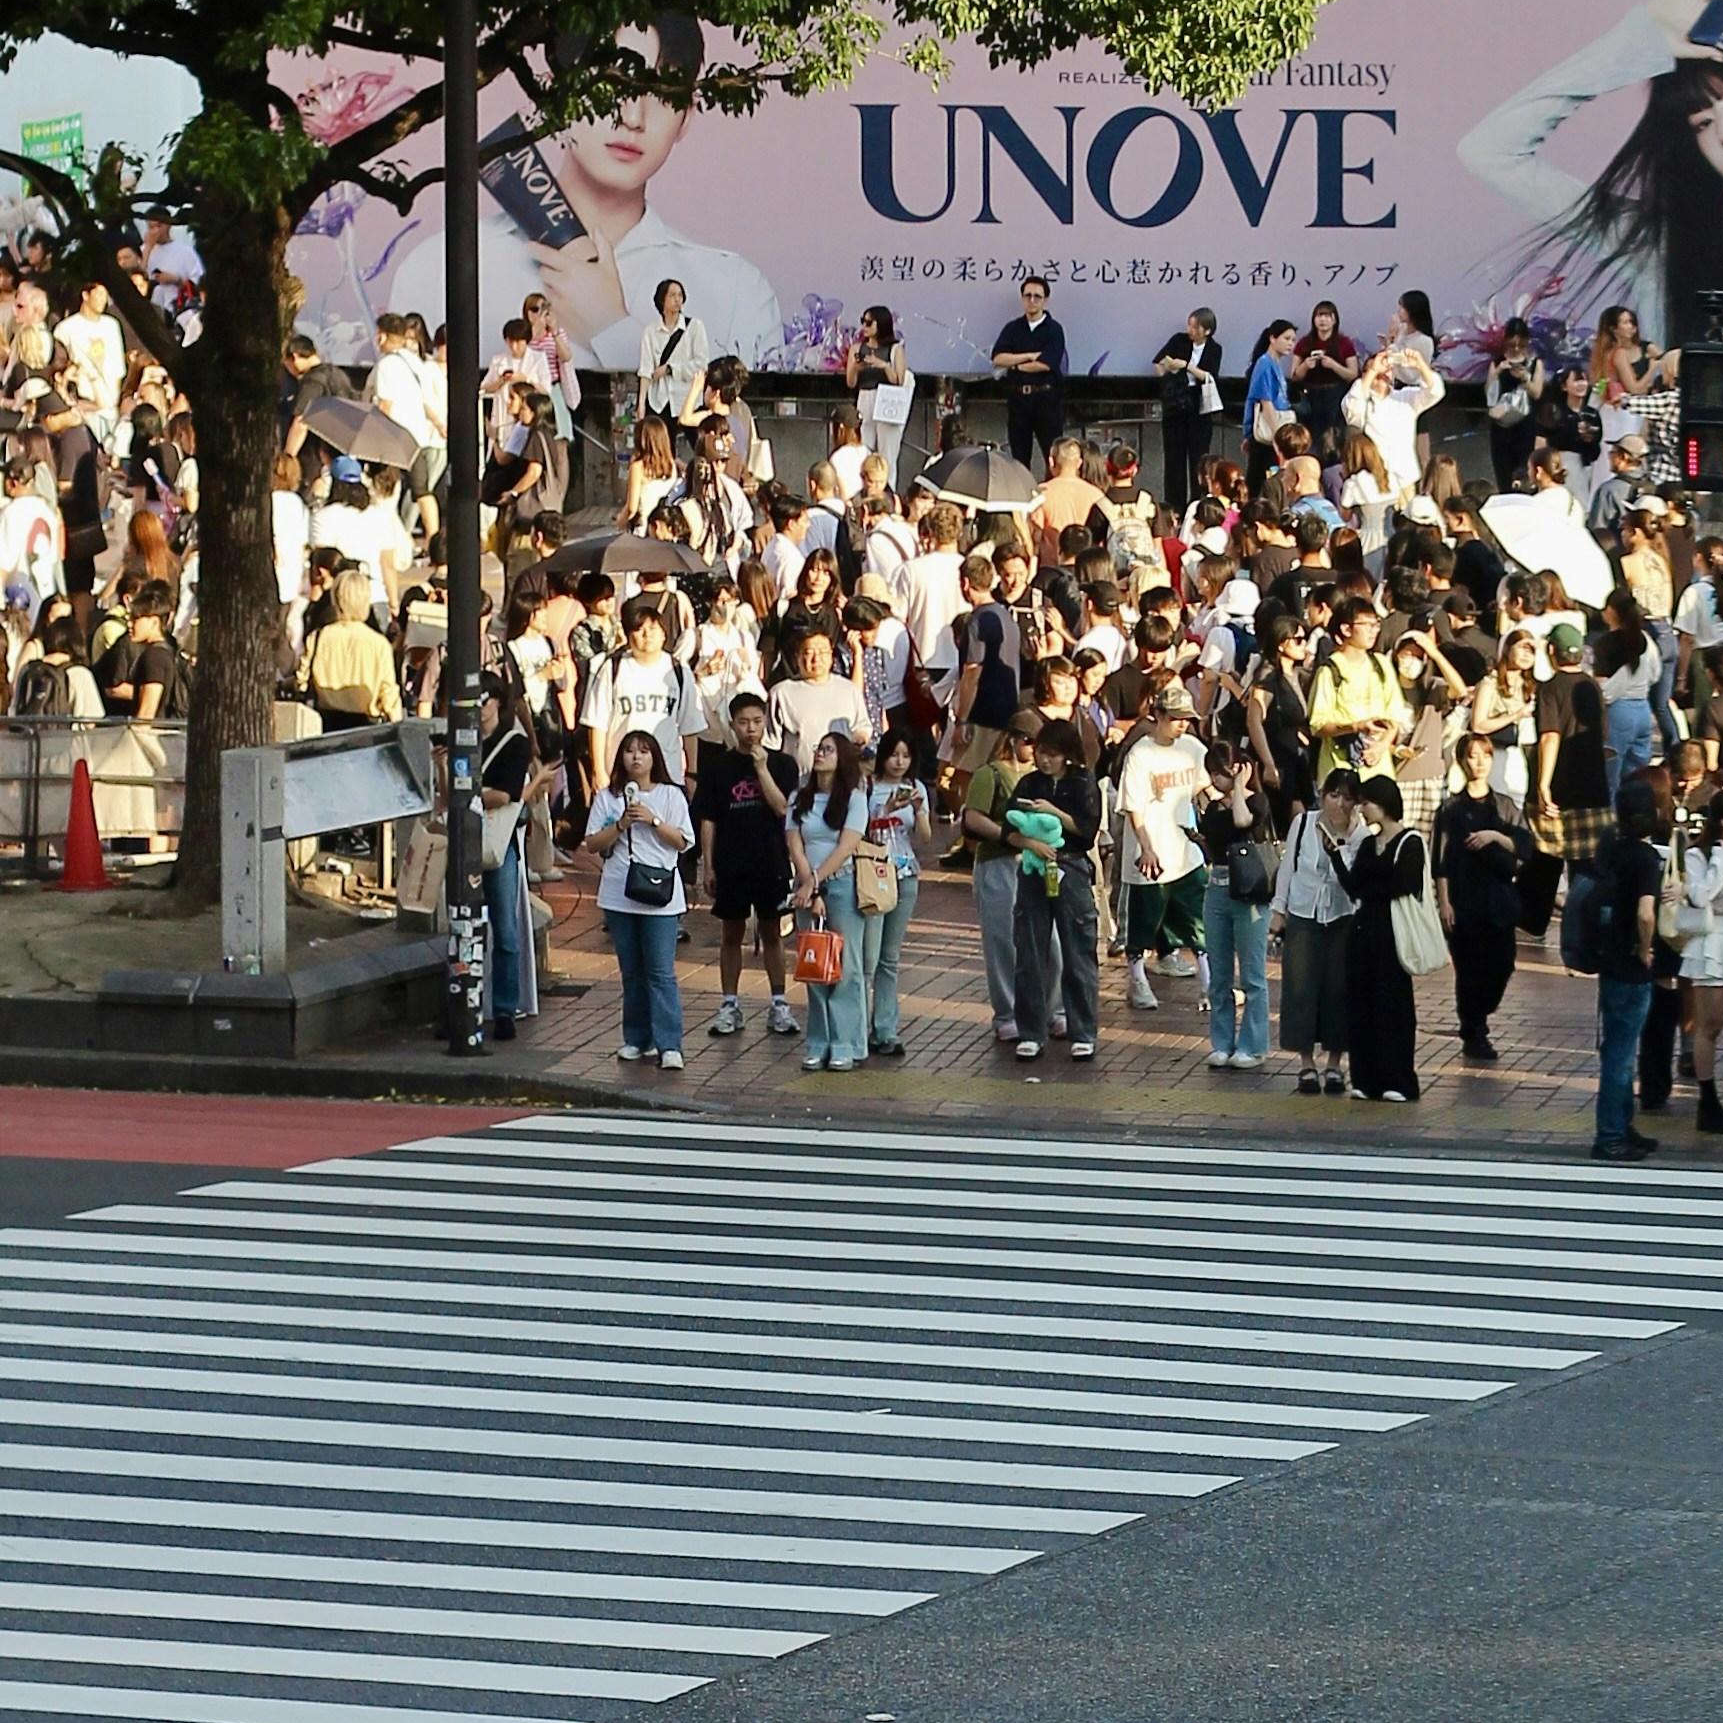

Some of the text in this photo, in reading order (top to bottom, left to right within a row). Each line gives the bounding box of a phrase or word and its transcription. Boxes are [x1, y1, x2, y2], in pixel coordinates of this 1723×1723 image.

[1058, 71, 1143, 85] REALIZE
[1286, 54, 1396, 96] Fantasy
[849, 103, 1398, 229] UNOVE
